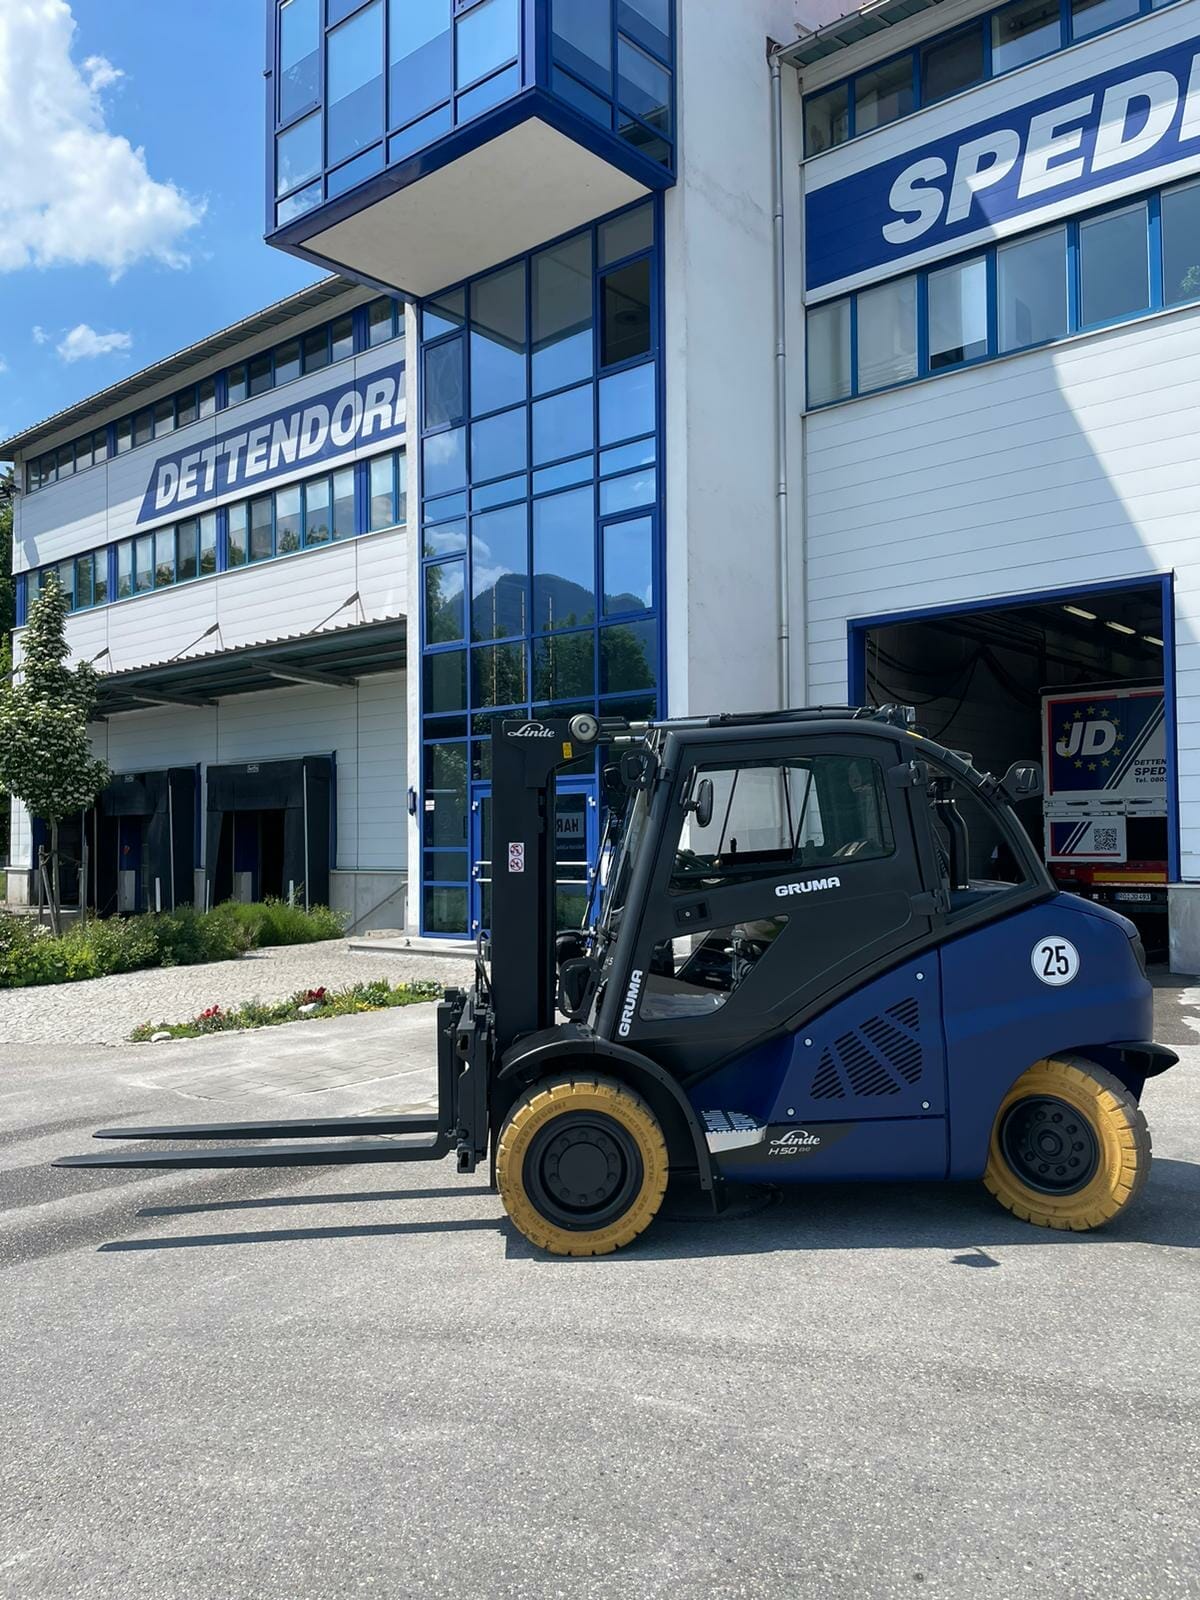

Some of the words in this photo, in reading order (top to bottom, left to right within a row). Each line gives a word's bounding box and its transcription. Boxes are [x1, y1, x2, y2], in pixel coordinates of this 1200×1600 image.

[507, 722, 555, 738] Linde
[1056, 720, 1116, 757] JD
[1134, 767, 1166, 776] SPED
[775, 876, 841, 897] GRUMA
[1041, 945, 1069, 976] 25
[618, 970, 643, 1037] GRUMA
[770, 1129, 821, 1146] Linde
